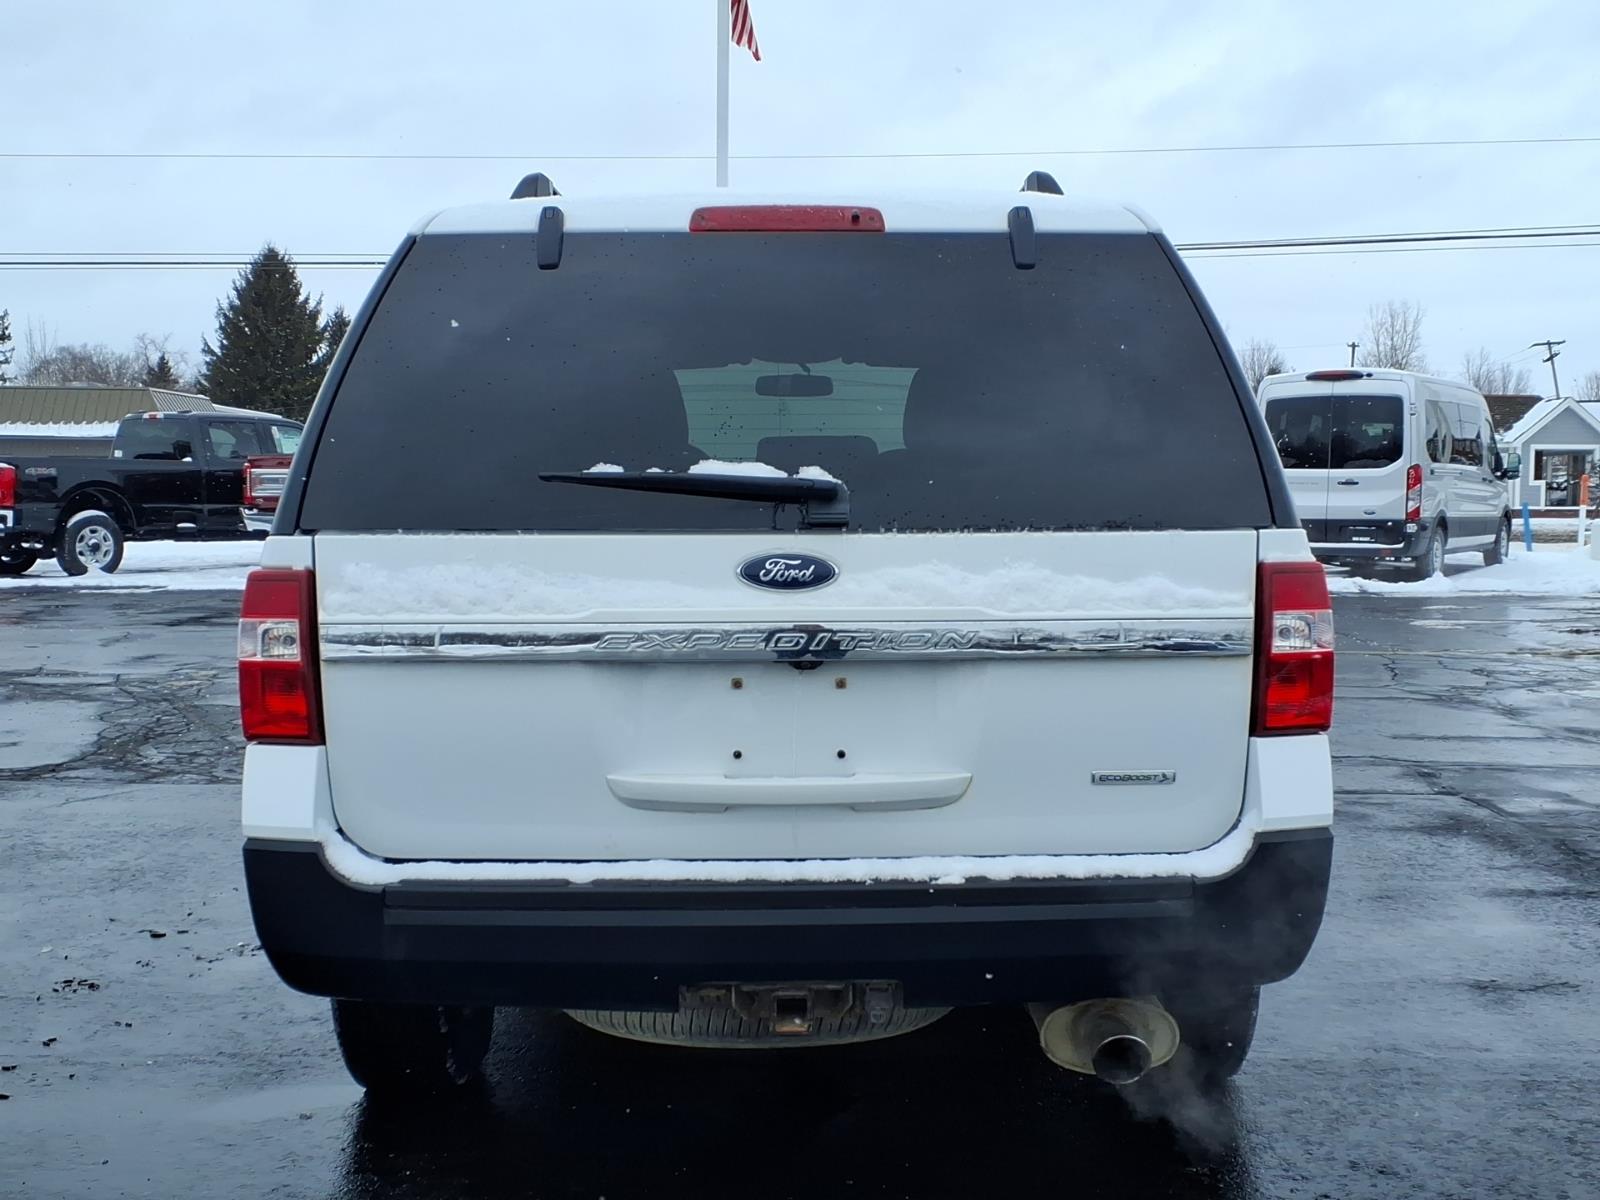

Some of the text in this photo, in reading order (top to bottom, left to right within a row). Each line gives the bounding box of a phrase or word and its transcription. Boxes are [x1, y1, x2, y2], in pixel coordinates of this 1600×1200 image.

[760, 558, 815, 581] Ford
[596, 631, 979, 650] EXPEDITION
[1099, 774, 1160, 782] ECOBOOST
